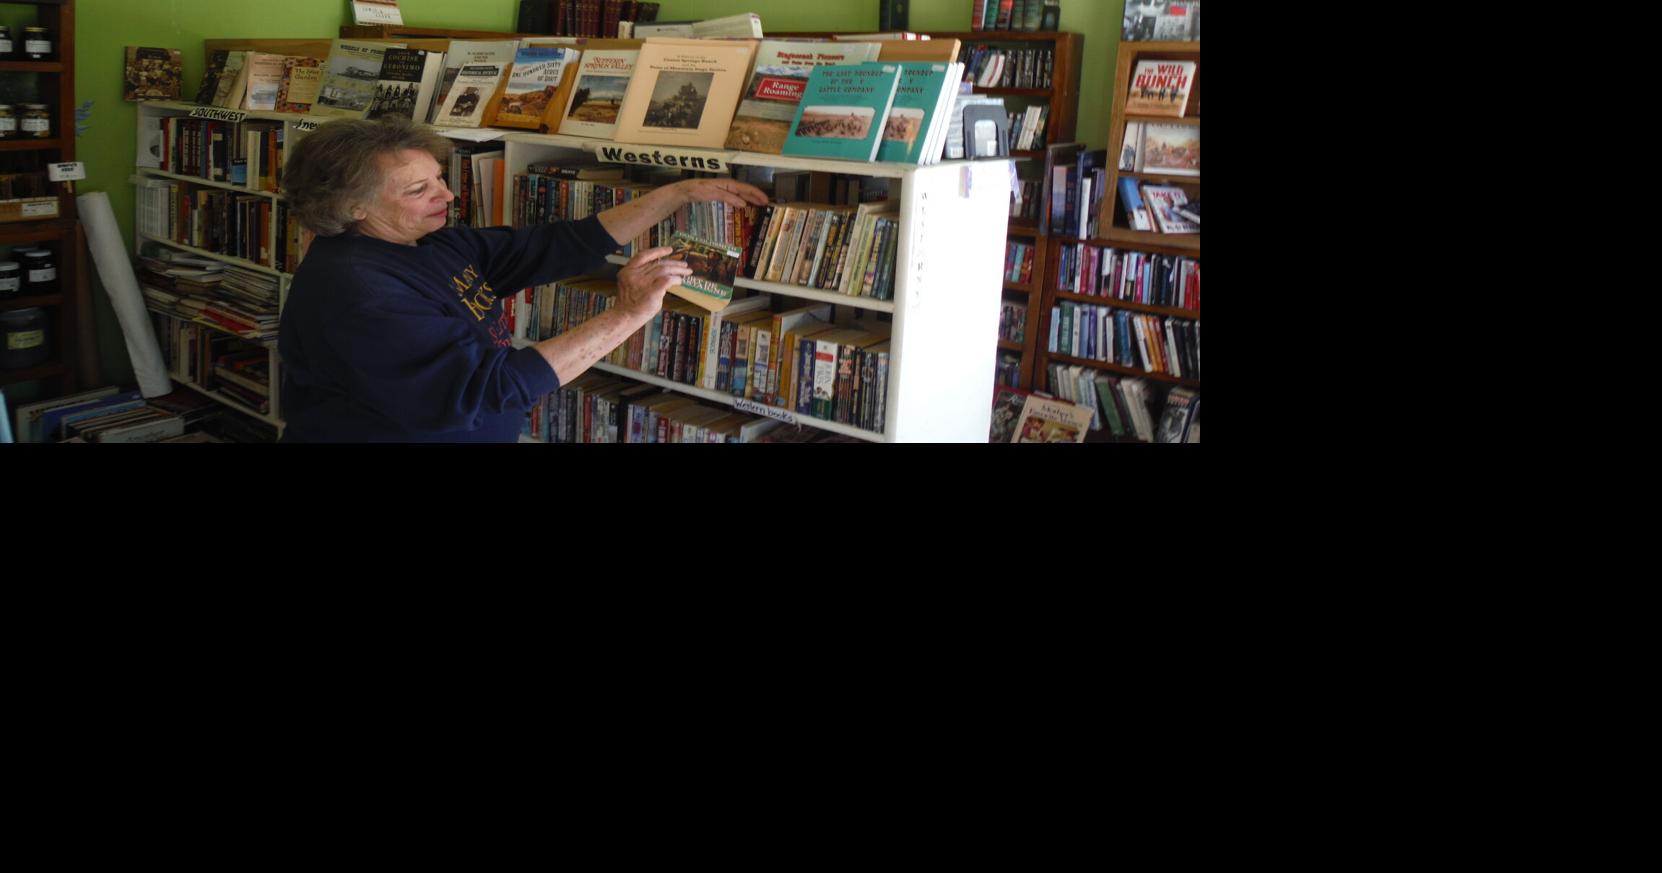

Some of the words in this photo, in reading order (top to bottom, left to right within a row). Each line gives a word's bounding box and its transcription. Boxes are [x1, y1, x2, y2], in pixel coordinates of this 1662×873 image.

[387, 54, 419, 62] COCHISE
[776, 51, 813, 60] Stagecoach
[383, 63, 421, 71] GERONIMO
[1157, 64, 1184, 75] WILD
[772, 81, 800, 92] Range
[1135, 74, 1188, 89] BUNCH
[191, 107, 246, 122] SOUTHWEST
[601, 146, 721, 170] Westerns
[735, 399, 766, 415] Western
[767, 407, 793, 422] books
